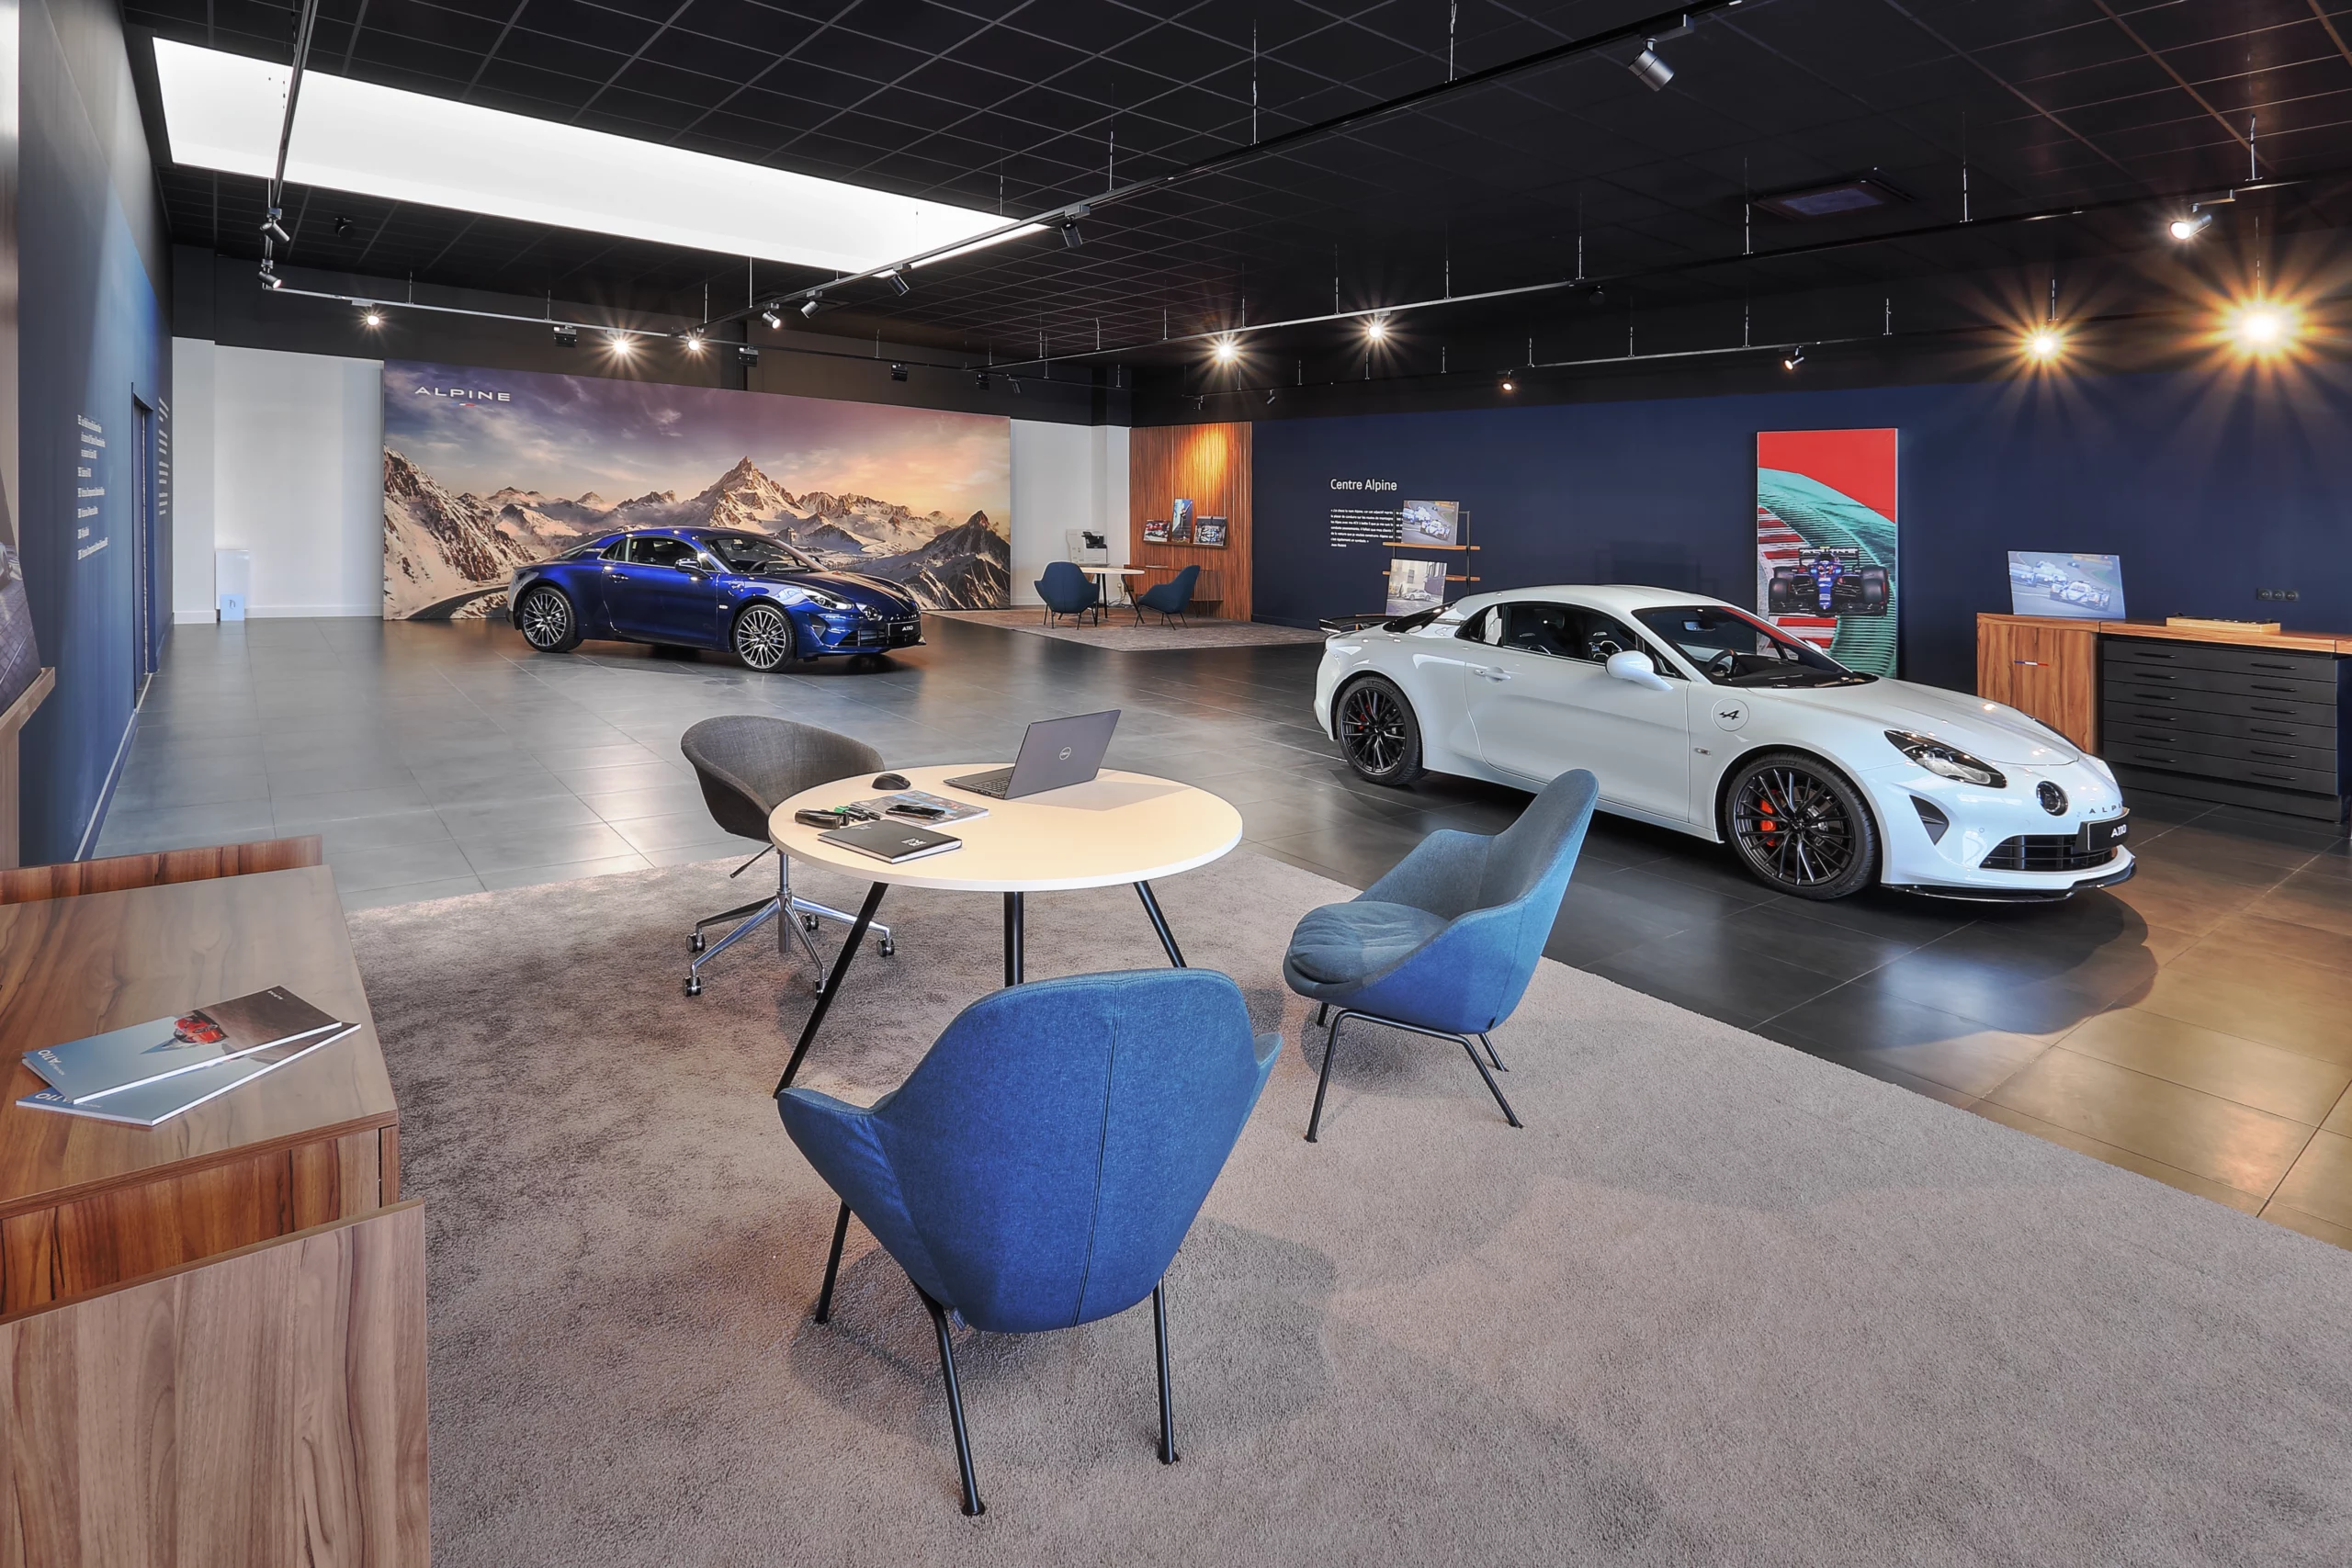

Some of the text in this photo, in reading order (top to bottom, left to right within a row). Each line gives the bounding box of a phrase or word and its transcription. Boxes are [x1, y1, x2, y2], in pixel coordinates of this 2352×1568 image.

[415, 387, 510, 401] ALPINE
[1330, 479, 1397, 492] Centre Alpine
[2110, 824, 2127, 838] A110
[38, 1049, 62, 1063] A110
